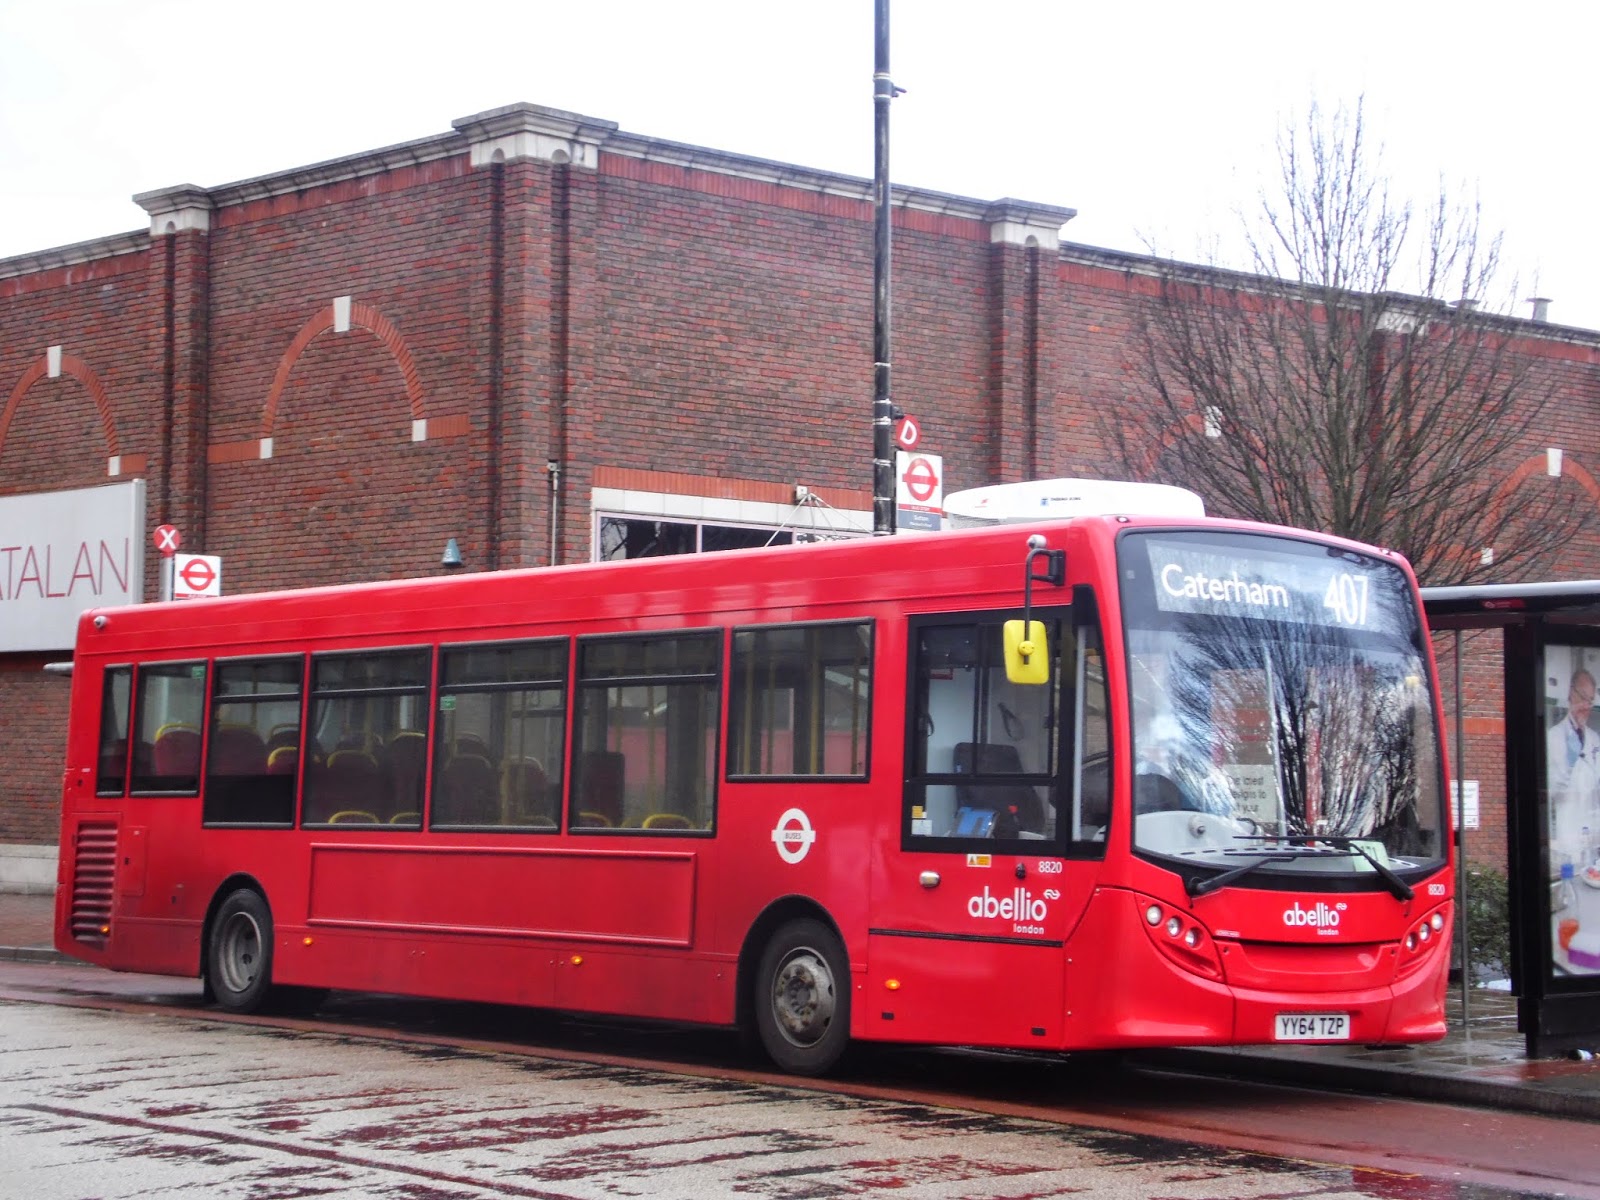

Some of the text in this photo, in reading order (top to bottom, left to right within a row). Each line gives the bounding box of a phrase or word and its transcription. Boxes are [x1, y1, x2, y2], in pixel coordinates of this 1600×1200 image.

[899, 419, 918, 445] D
[158, 529, 176, 549] X
[0, 537, 130, 600] TALAN
[1161, 563, 1369, 626] Caterham 407
[785, 832, 802, 840] BUSES
[1038, 861, 1062, 873] 8820
[968, 886, 1047, 921] abellio
[1283, 902, 1340, 927] abellio
[1013, 923, 1045, 934] london
[1317, 928, 1339, 936] london
[1281, 1018, 1344, 1035] YY64 TZP
